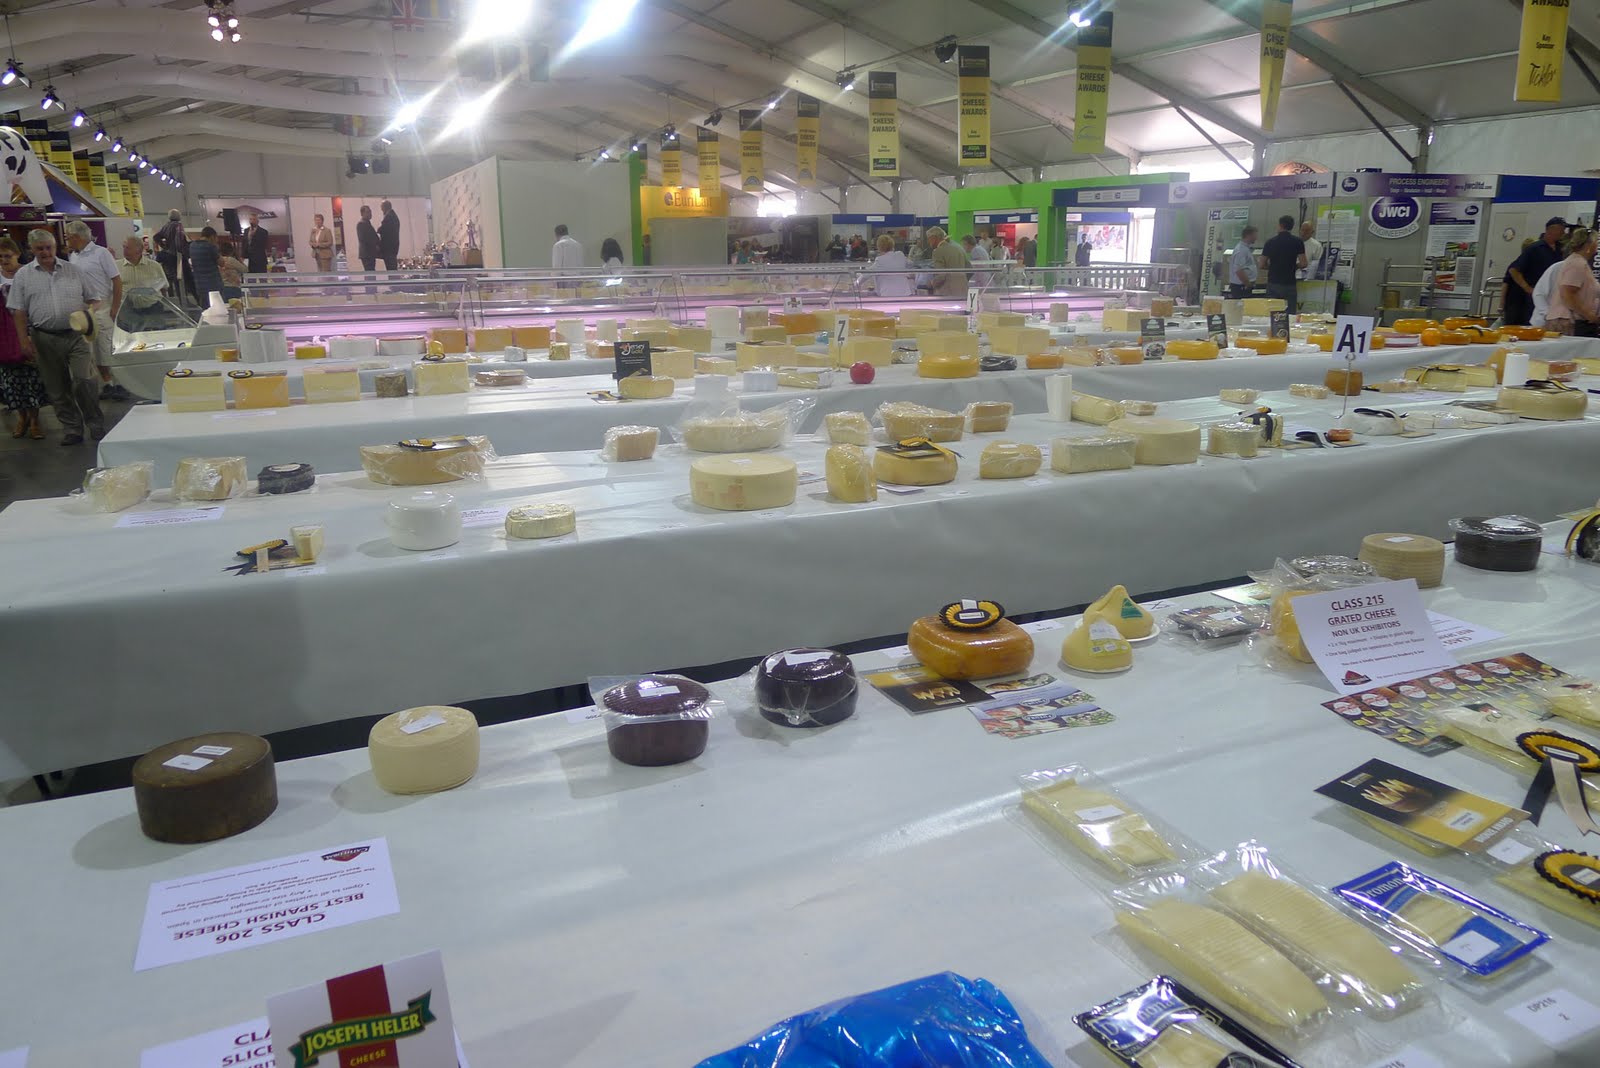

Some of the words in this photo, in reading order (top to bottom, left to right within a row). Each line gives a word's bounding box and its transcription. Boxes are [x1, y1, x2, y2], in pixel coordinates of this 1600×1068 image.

[1080, 73, 1104, 82] CHEESE
[1379, 206, 1410, 218] JWCI
[1370, 223, 1418, 236] ENGINEERING
[969, 293, 978, 310] Y
[837, 320, 847, 342] Z
[1336, 324, 1366, 354] A1
[1331, 598, 1364, 610] CLASS
[1366, 594, 1384, 606] 215
[1328, 613, 1362, 626] GRATED
[1364, 608, 1396, 620] CHEESE
[1332, 628, 1349, 638] NON
[1350, 626, 1360, 634] UK
[1361, 620, 1402, 632] EXHIBITORS
[1356, 877, 1406, 900] Dromon
[325, 892, 364, 908] BEST
[247, 903, 319, 925] SPANISH
[174, 920, 240, 941] CHEESE
[261, 913, 326, 935] CLASS
[216, 928, 253, 944] 206
[306, 1022, 368, 1056] JOSEPH
[371, 1012, 421, 1037] HELER
[350, 1048, 386, 1066] CHEESE
